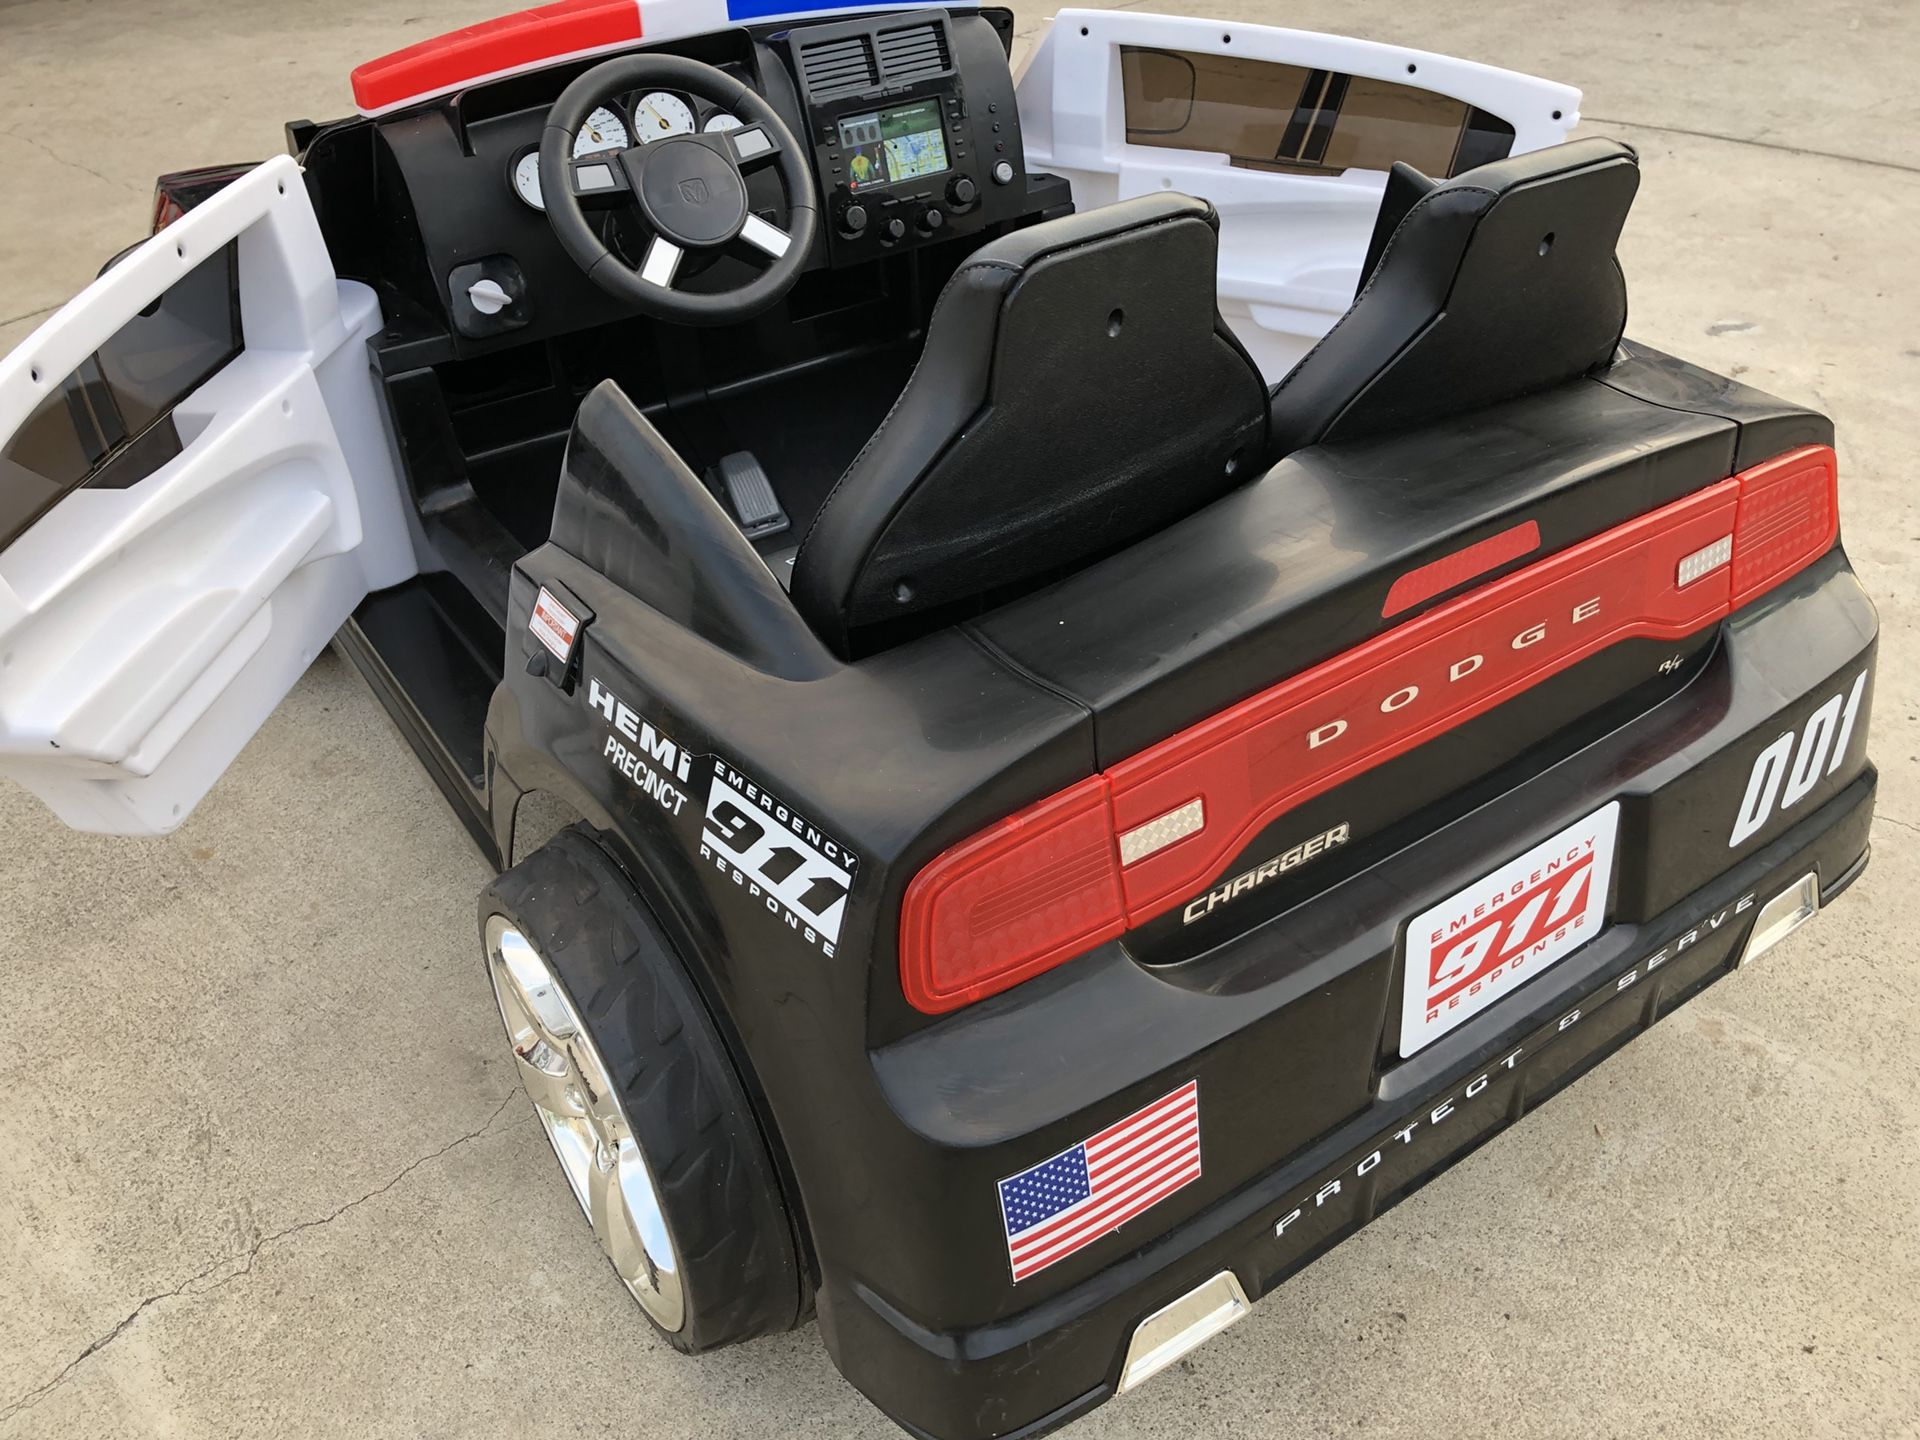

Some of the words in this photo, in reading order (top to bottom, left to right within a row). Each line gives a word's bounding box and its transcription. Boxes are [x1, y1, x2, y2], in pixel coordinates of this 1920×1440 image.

[1309, 597, 1600, 749] DODGE
[603, 735, 687, 816] PRECINCT
[714, 761, 856, 867] EMERGENCY
[1728, 668, 1868, 848] 001
[700, 843, 835, 958] RESPONSE
[705, 800, 849, 916] 911
[1183, 822, 1349, 925] CHARGER
[1431, 835, 1596, 943] EMERGENCY
[1426, 915, 1584, 1024] RESPONSE
[1434, 866, 1593, 981] 911
[1275, 1048, 1522, 1237] PROTECT
[1558, 1010, 1581, 1031] &
[1616, 893, 1755, 991] SERVE
